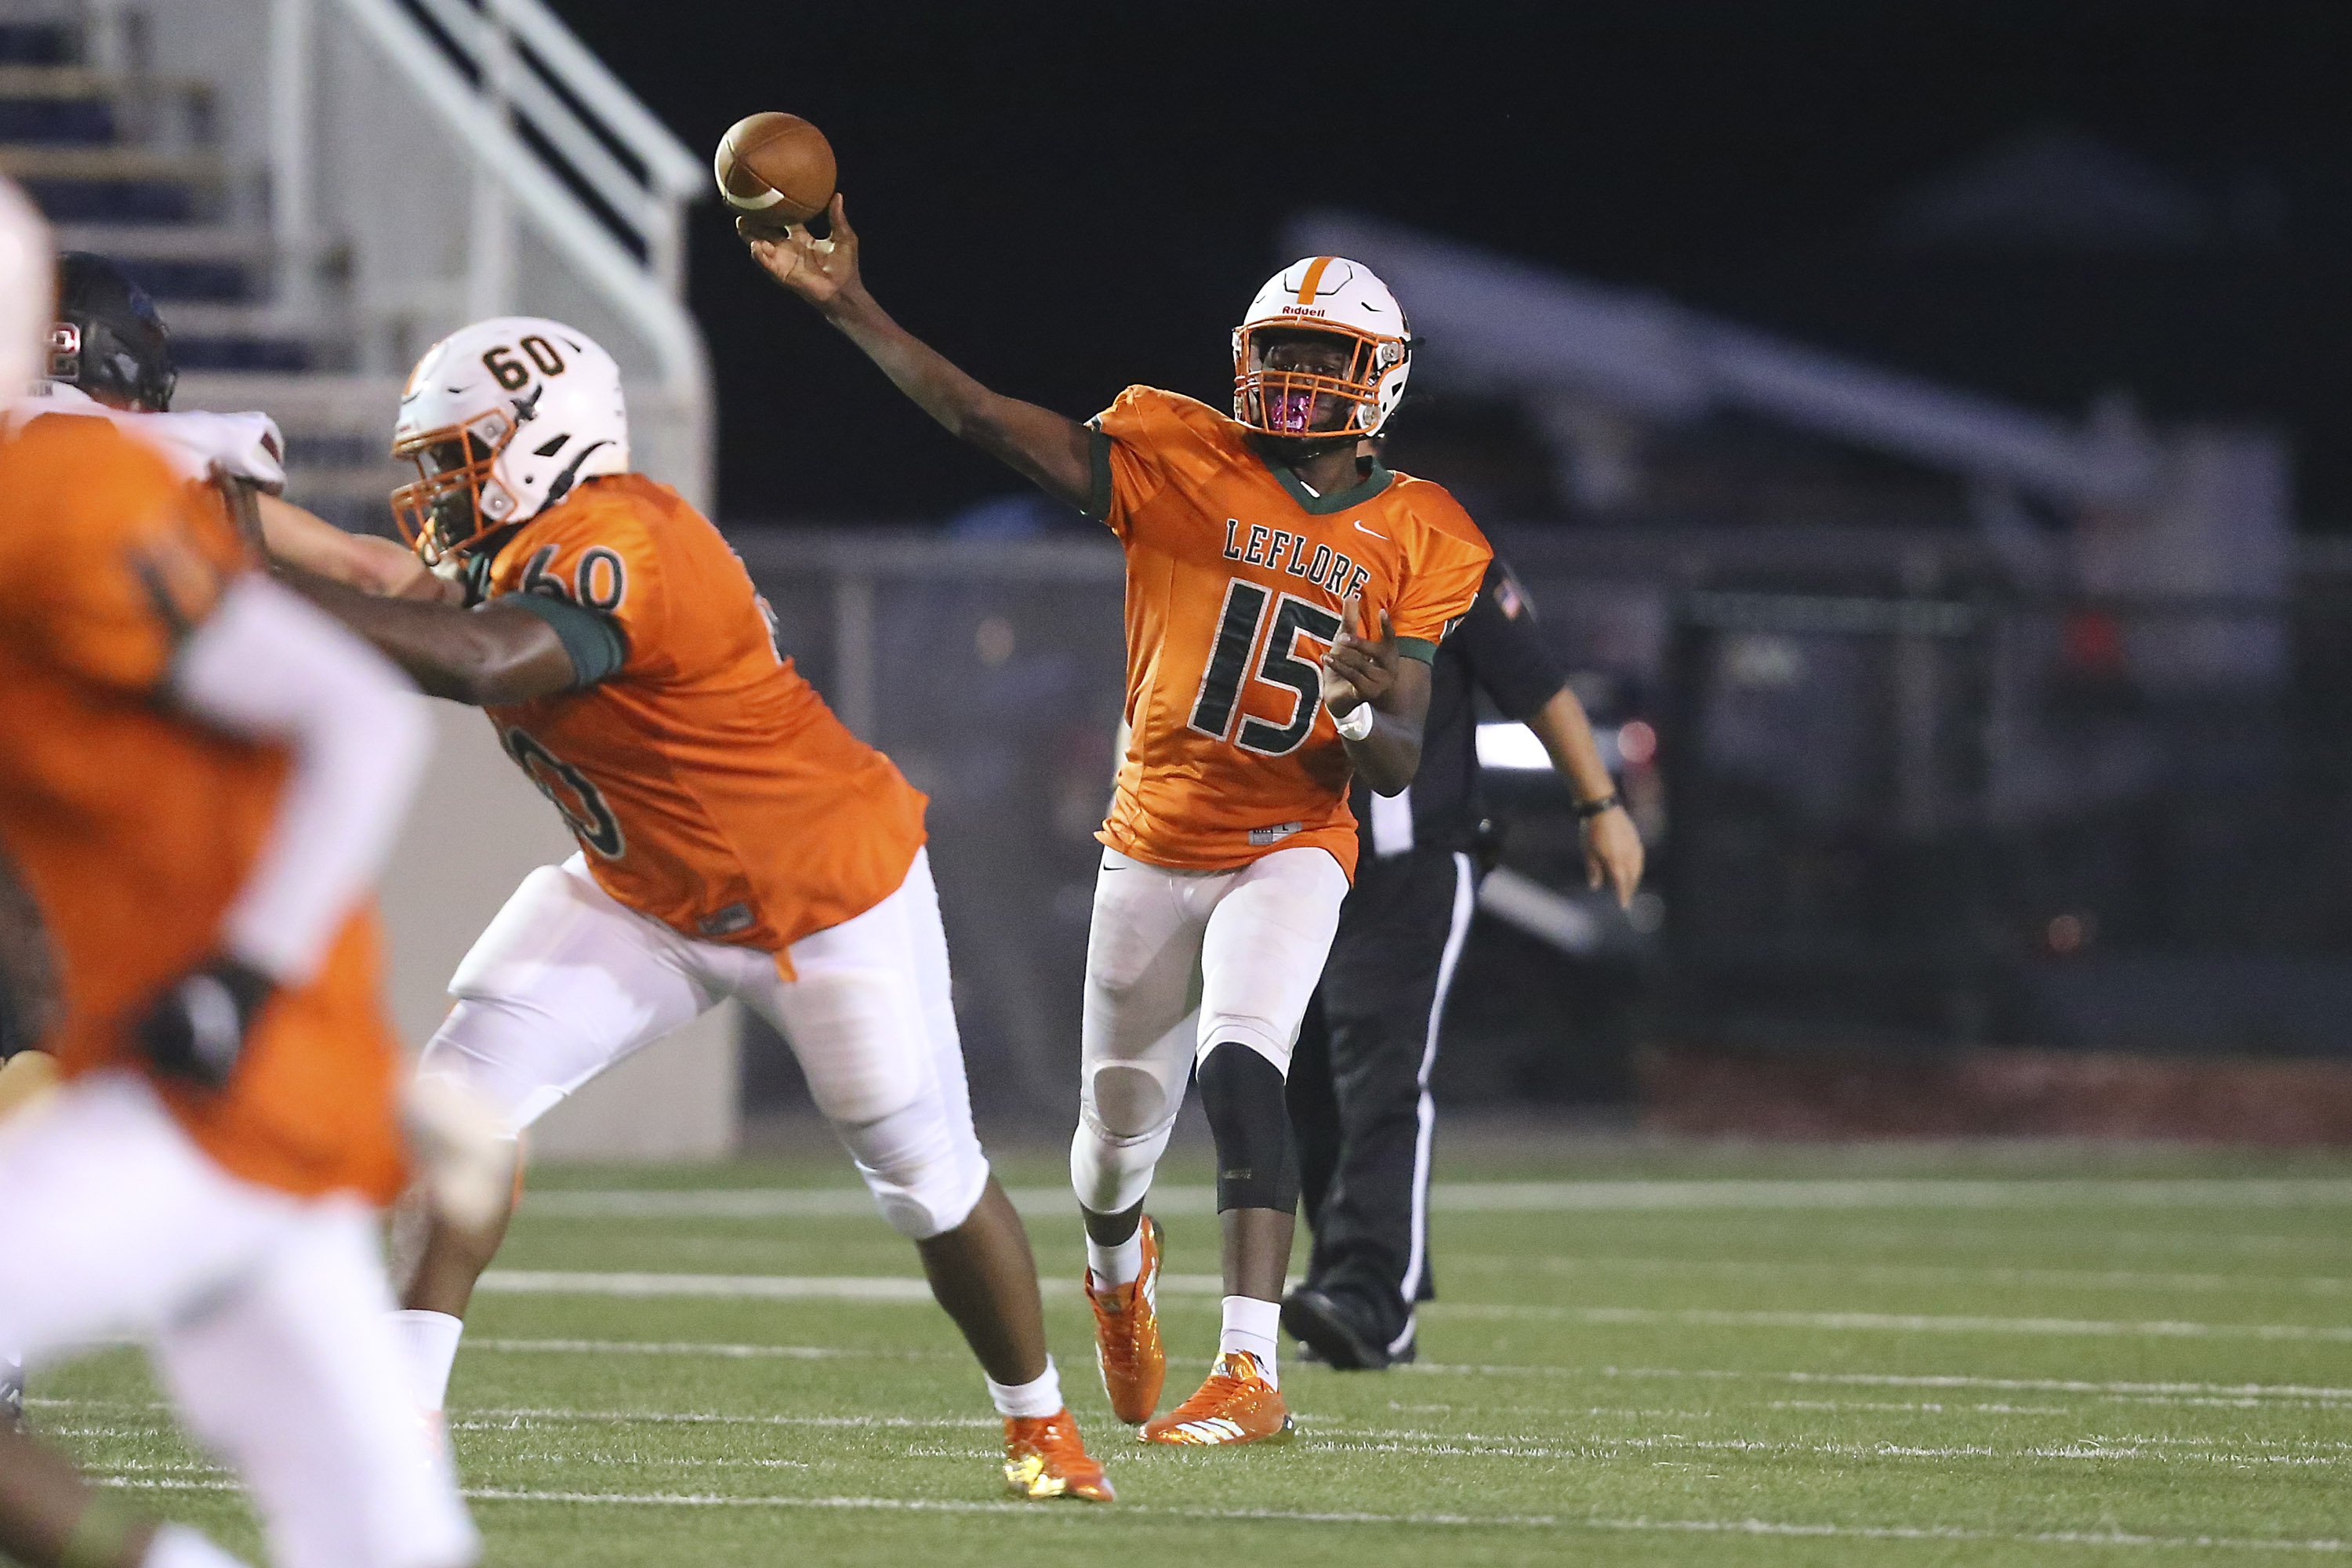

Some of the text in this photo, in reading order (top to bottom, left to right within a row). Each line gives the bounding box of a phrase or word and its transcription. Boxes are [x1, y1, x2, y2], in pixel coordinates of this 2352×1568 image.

[1282, 306, 1325, 318] Riddell
[481, 335, 564, 390] 60
[517, 543, 628, 612] 60
[1222, 518, 1371, 601] LEFLORE
[1186, 576, 1343, 757] 15
